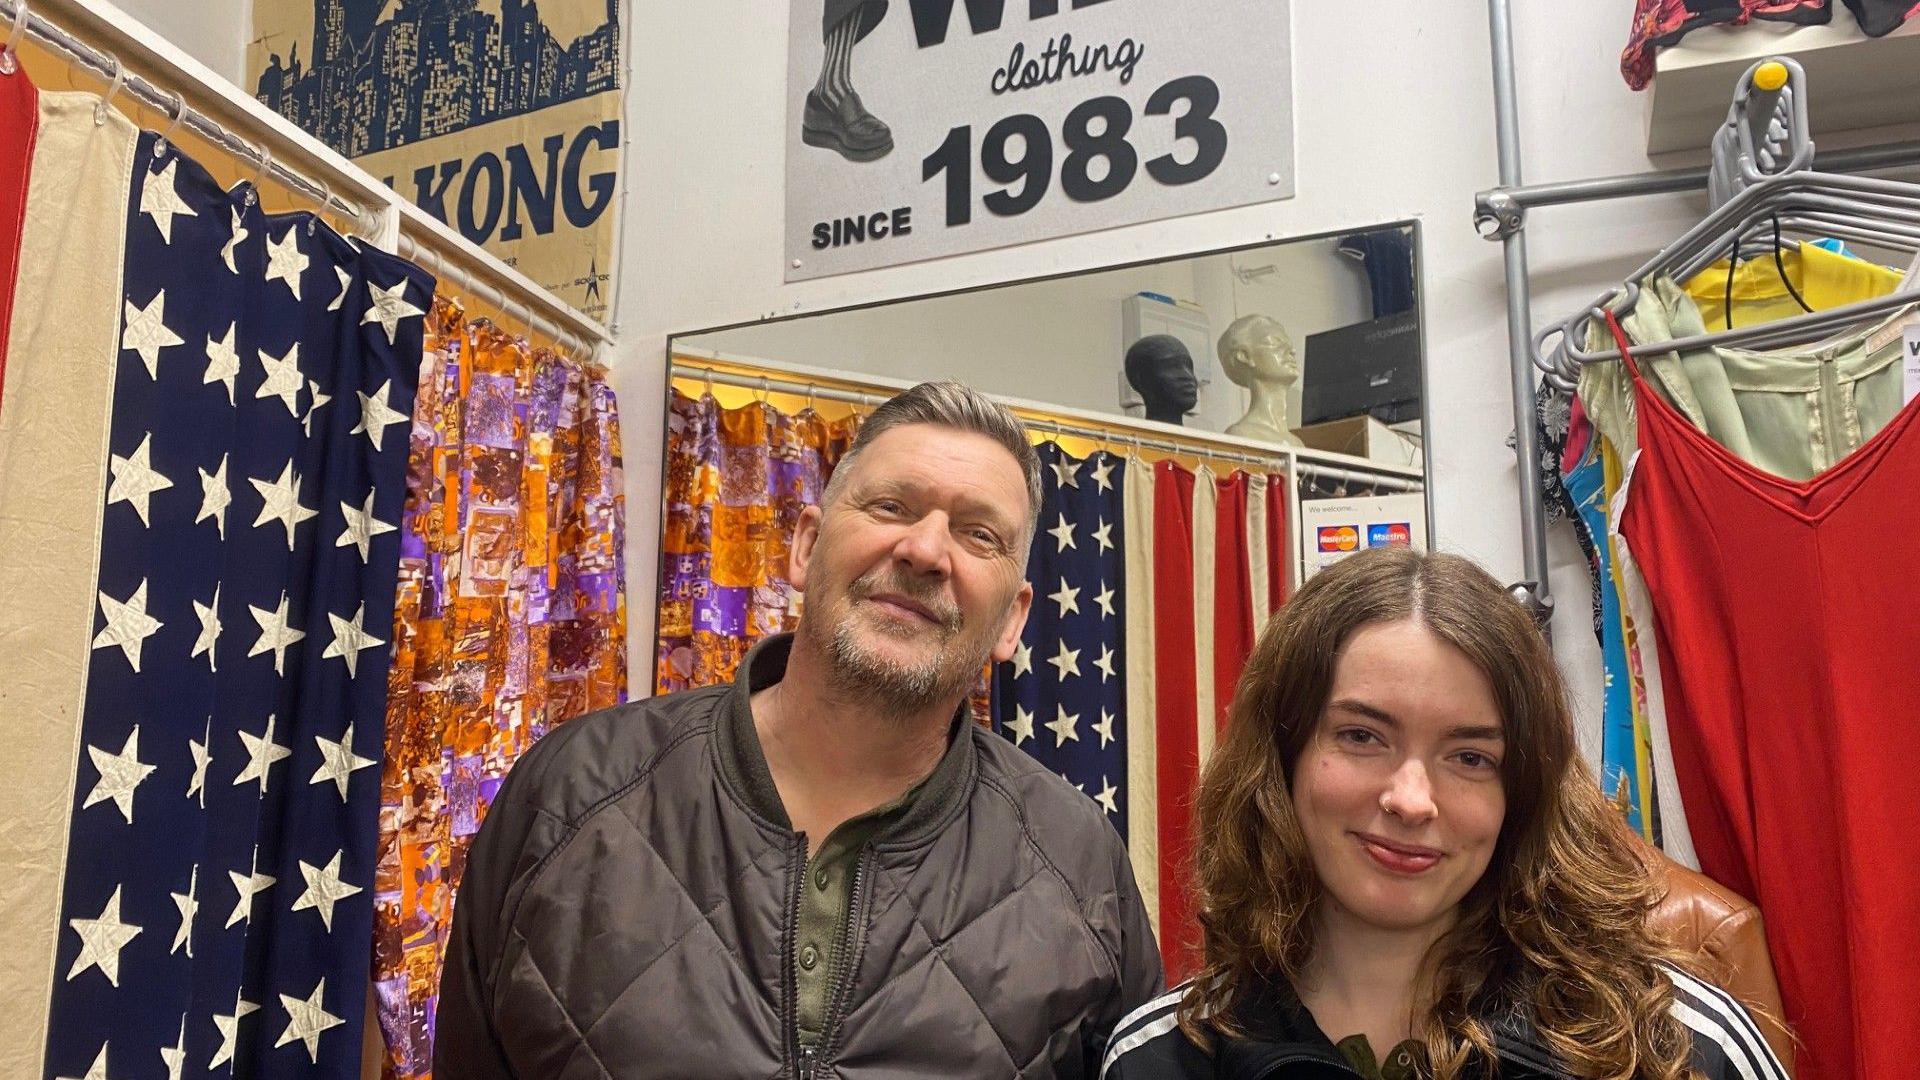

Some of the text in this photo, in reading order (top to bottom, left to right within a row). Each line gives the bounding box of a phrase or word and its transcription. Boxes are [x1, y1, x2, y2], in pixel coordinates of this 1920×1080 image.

[992, 33, 1144, 94] clothing
[413, 120, 620, 246] KONG
[812, 75, 1227, 250] SINCE 1983
[1320, 534, 1357, 544] MasterCard
[1372, 532, 1406, 542] Maestro
